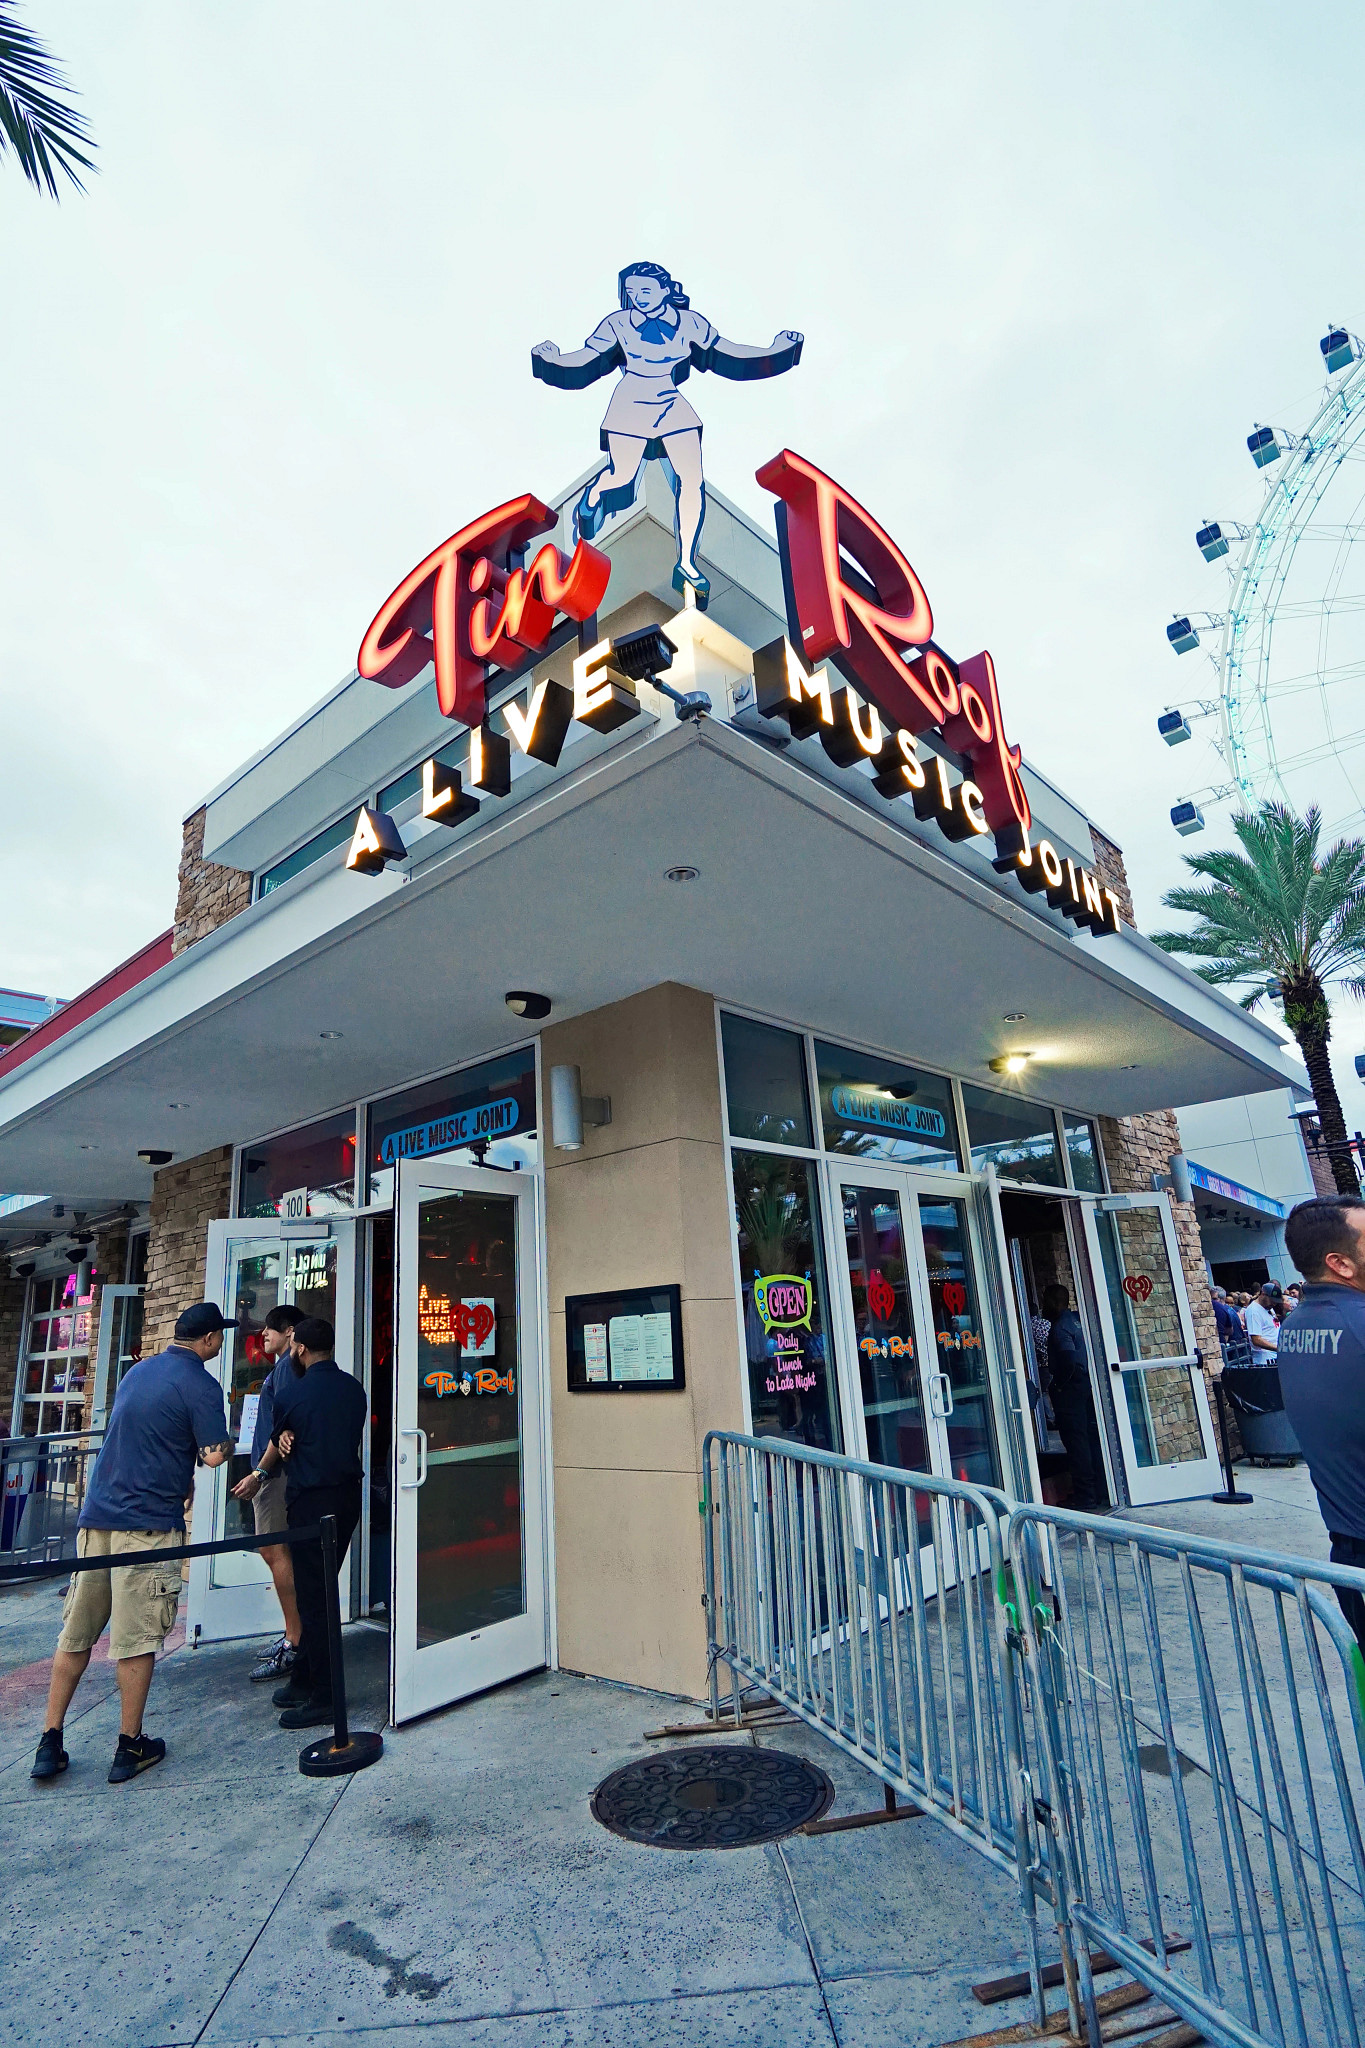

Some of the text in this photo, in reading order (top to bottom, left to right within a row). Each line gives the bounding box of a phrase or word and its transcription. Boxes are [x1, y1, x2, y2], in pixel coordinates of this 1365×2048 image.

[357, 448, 1032, 831] Tin Roof
[346, 634, 1122, 934] A LIVE MUSIC JOINT
[838, 1090, 942, 1134] A LIVE MUSIC JOINT
[386, 1101, 513, 1160] A LIVE MUSIC JOINT
[286, 1195, 303, 1217] 100
[419, 1284, 428, 1299] A
[768, 1285, 806, 1317] OPEN
[419, 1300, 450, 1314] LIVE
[420, 1315, 457, 1331] MUSI
[776, 1333, 799, 1351] Daily
[860, 1335, 914, 1360] Tin Roof
[937, 1331, 955, 1351] Tin
[776, 1356, 803, 1372] Lunch
[423, 1367, 516, 1397] Tin Roof
[765, 1371, 817, 1392] to Late Night
